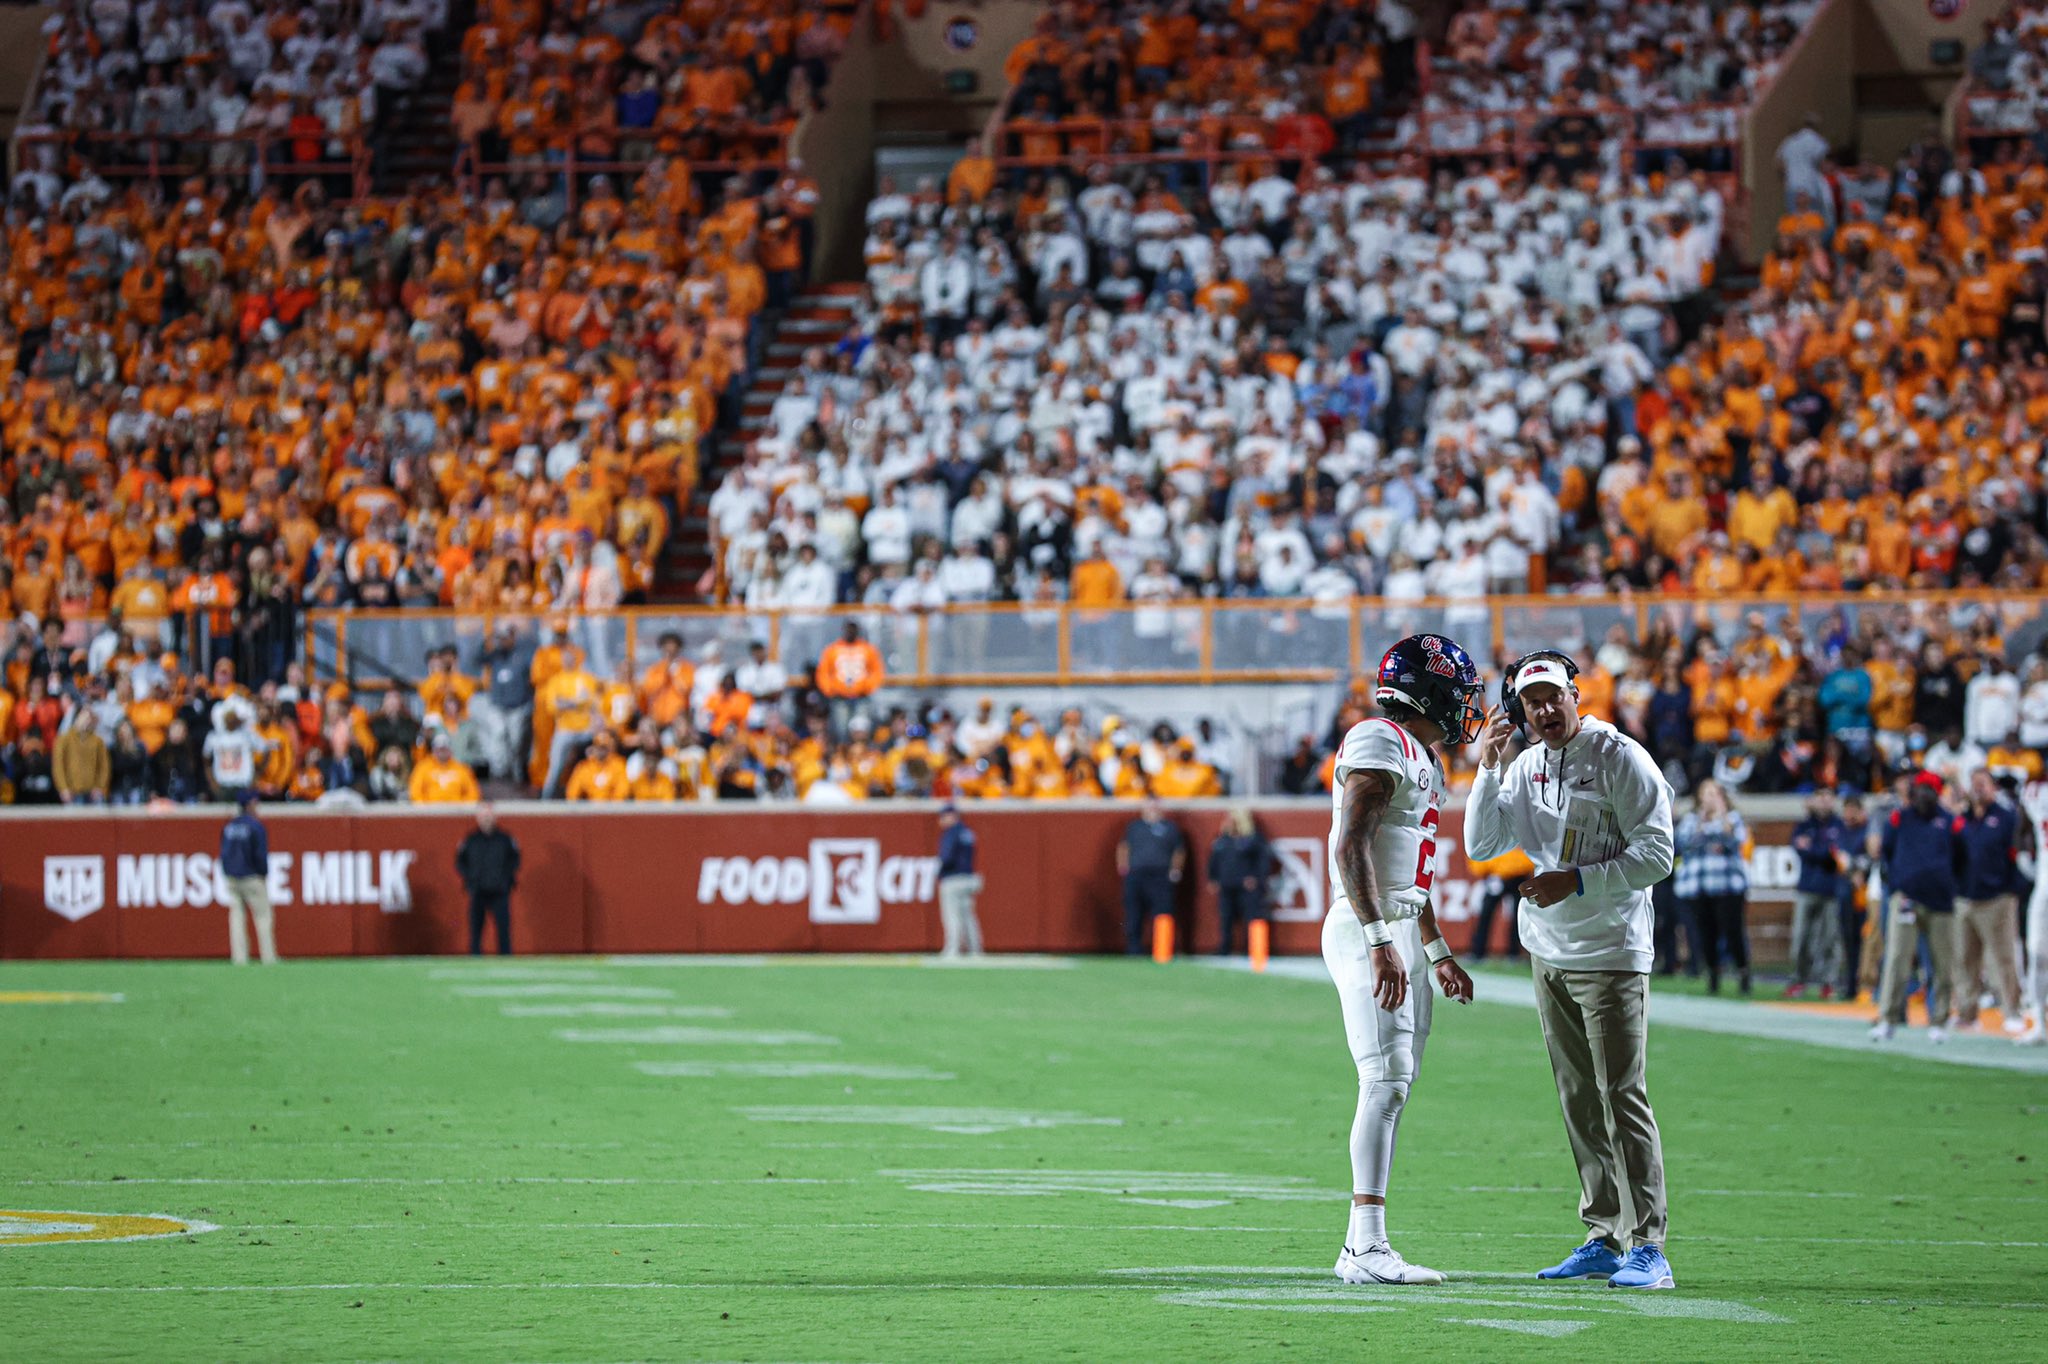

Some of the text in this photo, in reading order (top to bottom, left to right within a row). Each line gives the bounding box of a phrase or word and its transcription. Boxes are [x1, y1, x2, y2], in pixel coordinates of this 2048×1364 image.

[1421, 636, 1442, 651] Ole
[1426, 650, 1455, 678] Miss
[116, 850, 412, 911] MUSE MILK
[697, 855, 809, 904] FOOD
[878, 855, 943, 903] CIT
